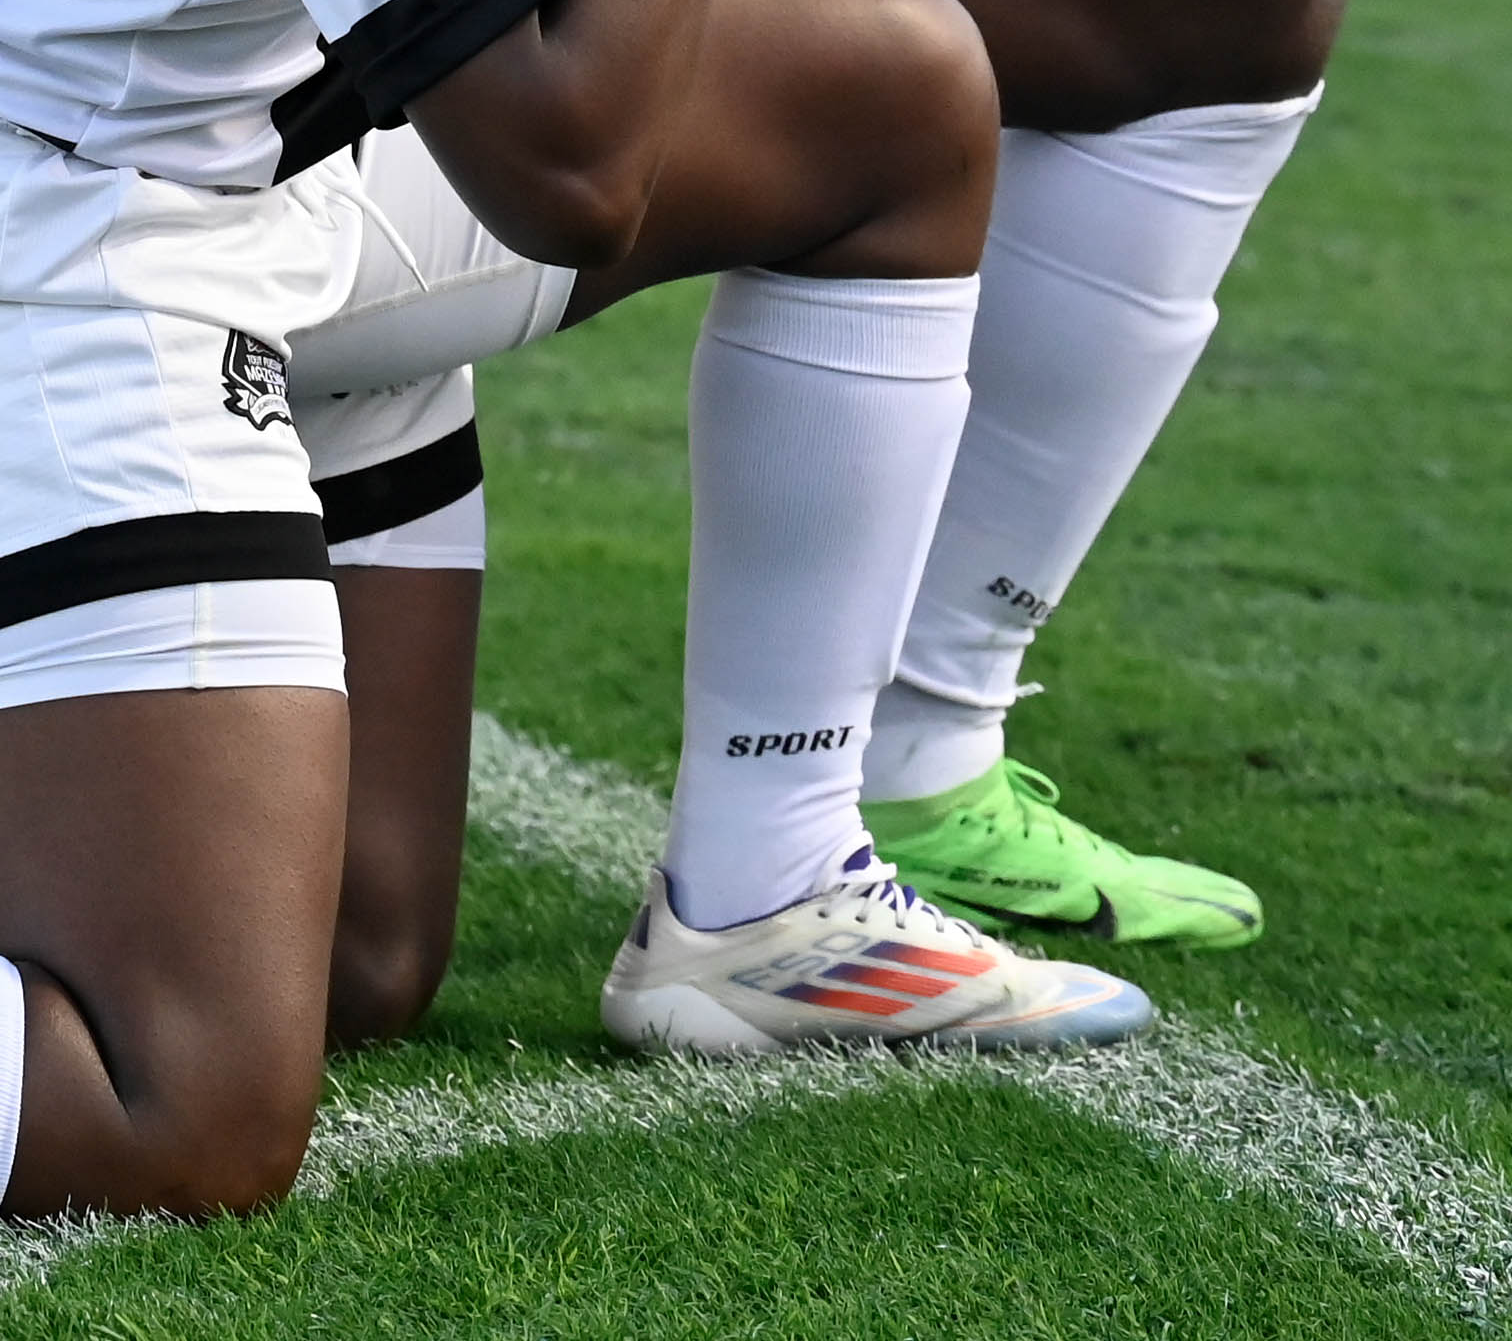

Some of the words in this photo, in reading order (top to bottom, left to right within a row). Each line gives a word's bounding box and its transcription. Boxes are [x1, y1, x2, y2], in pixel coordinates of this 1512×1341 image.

[987, 576, 1052, 621] SPO
[727, 725, 855, 758] SPORT
[728, 930, 870, 991] F50
